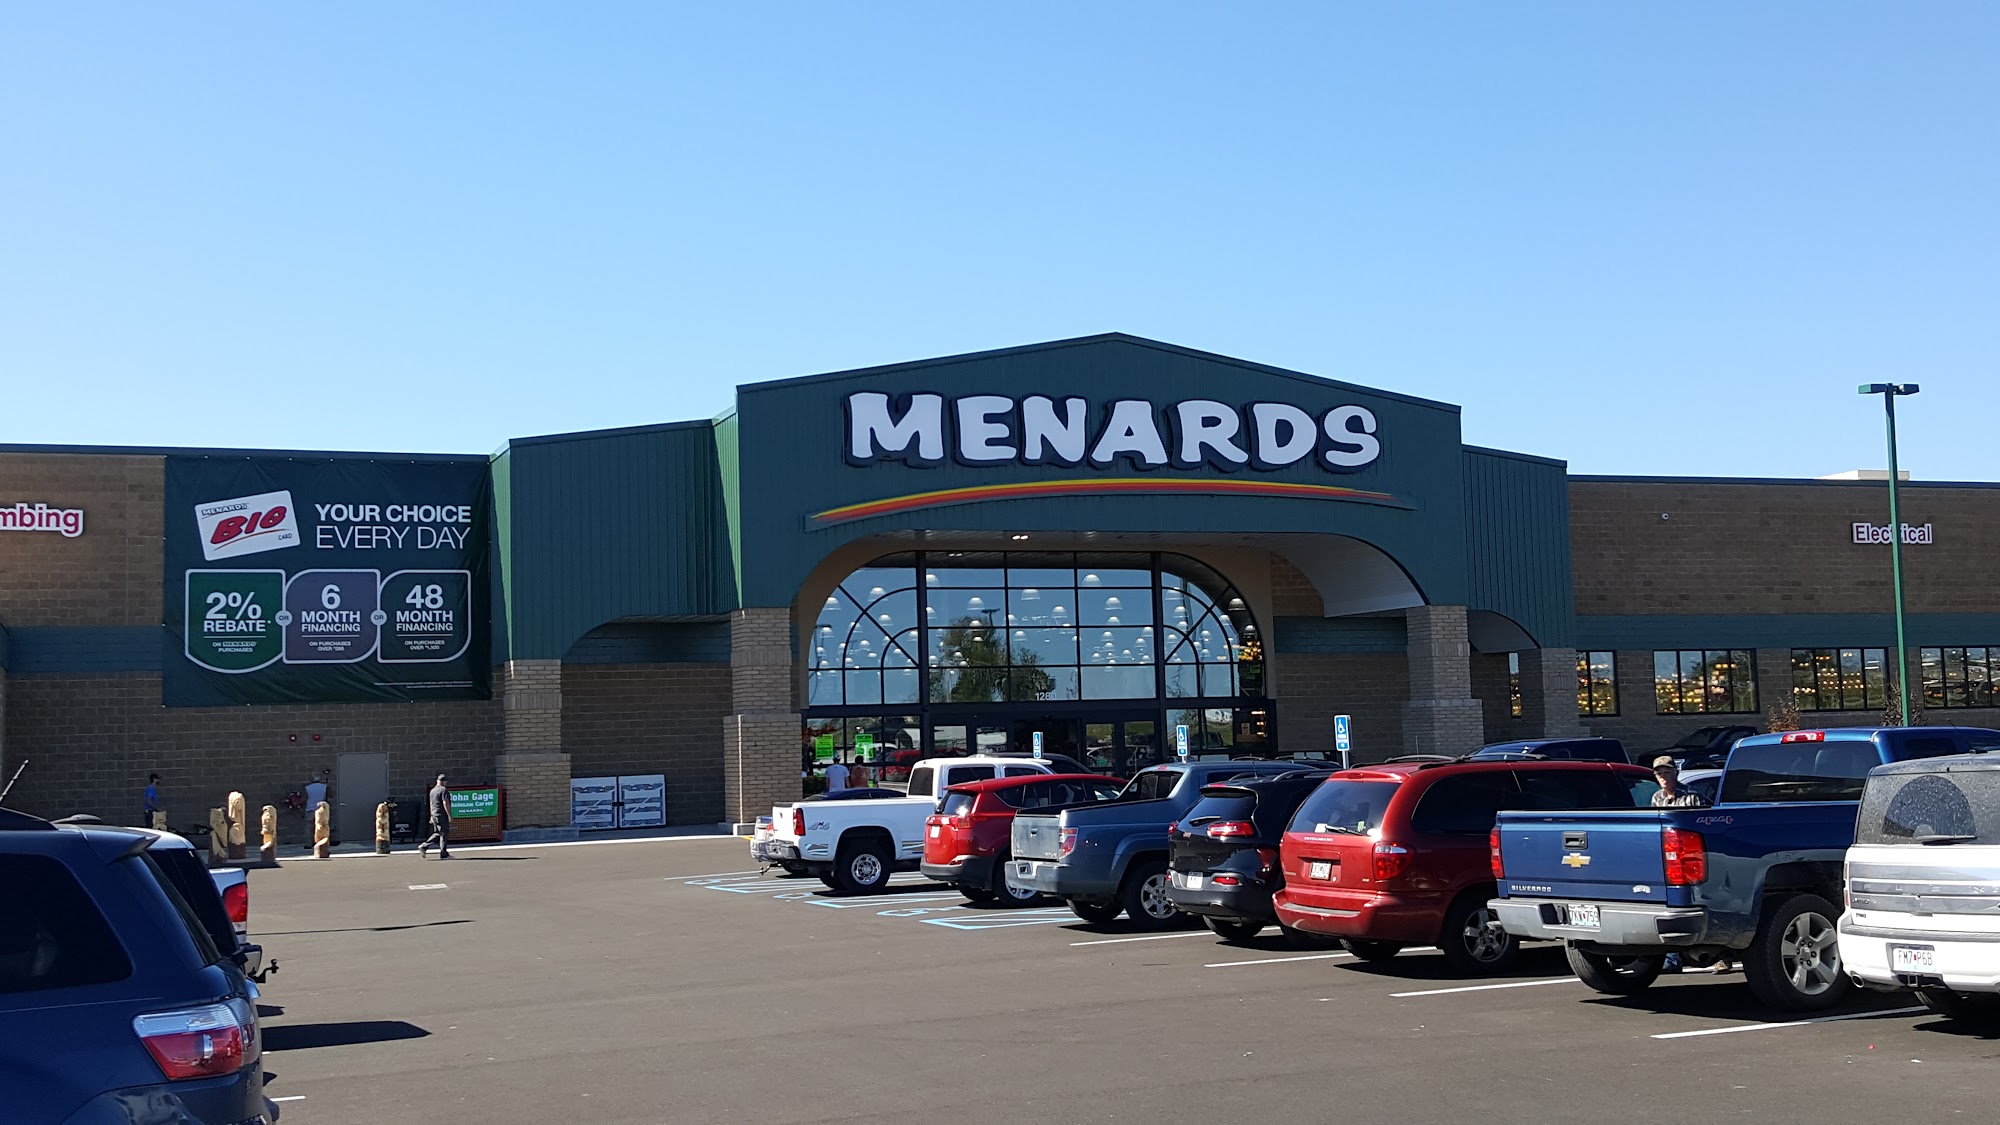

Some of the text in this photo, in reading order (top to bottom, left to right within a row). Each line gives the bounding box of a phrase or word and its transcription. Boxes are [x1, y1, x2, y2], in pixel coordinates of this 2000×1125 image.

[847, 391, 1381, 468] MENARDS
[0, 504, 82, 536] mbing
[202, 503, 248, 517] MENARDS
[314, 503, 472, 523] YOUR CHOICE
[210, 505, 287, 545] BIG
[1854, 523, 1933, 543] Elecical
[316, 525, 472, 550] EVERY DAY
[205, 591, 262, 620] 2%
[321, 584, 341, 610] 6
[405, 584, 444, 609] 48
[301, 610, 361, 623] MONTH
[395, 610, 454, 622] MONTH
[301, 623, 361, 632] FINANCING
[395, 622, 454, 632] FINANCING
[1035, 692, 1056, 701] 1280
[472, 793, 494, 801] Gage
[1511, 884, 1552, 893] SILVERADO
